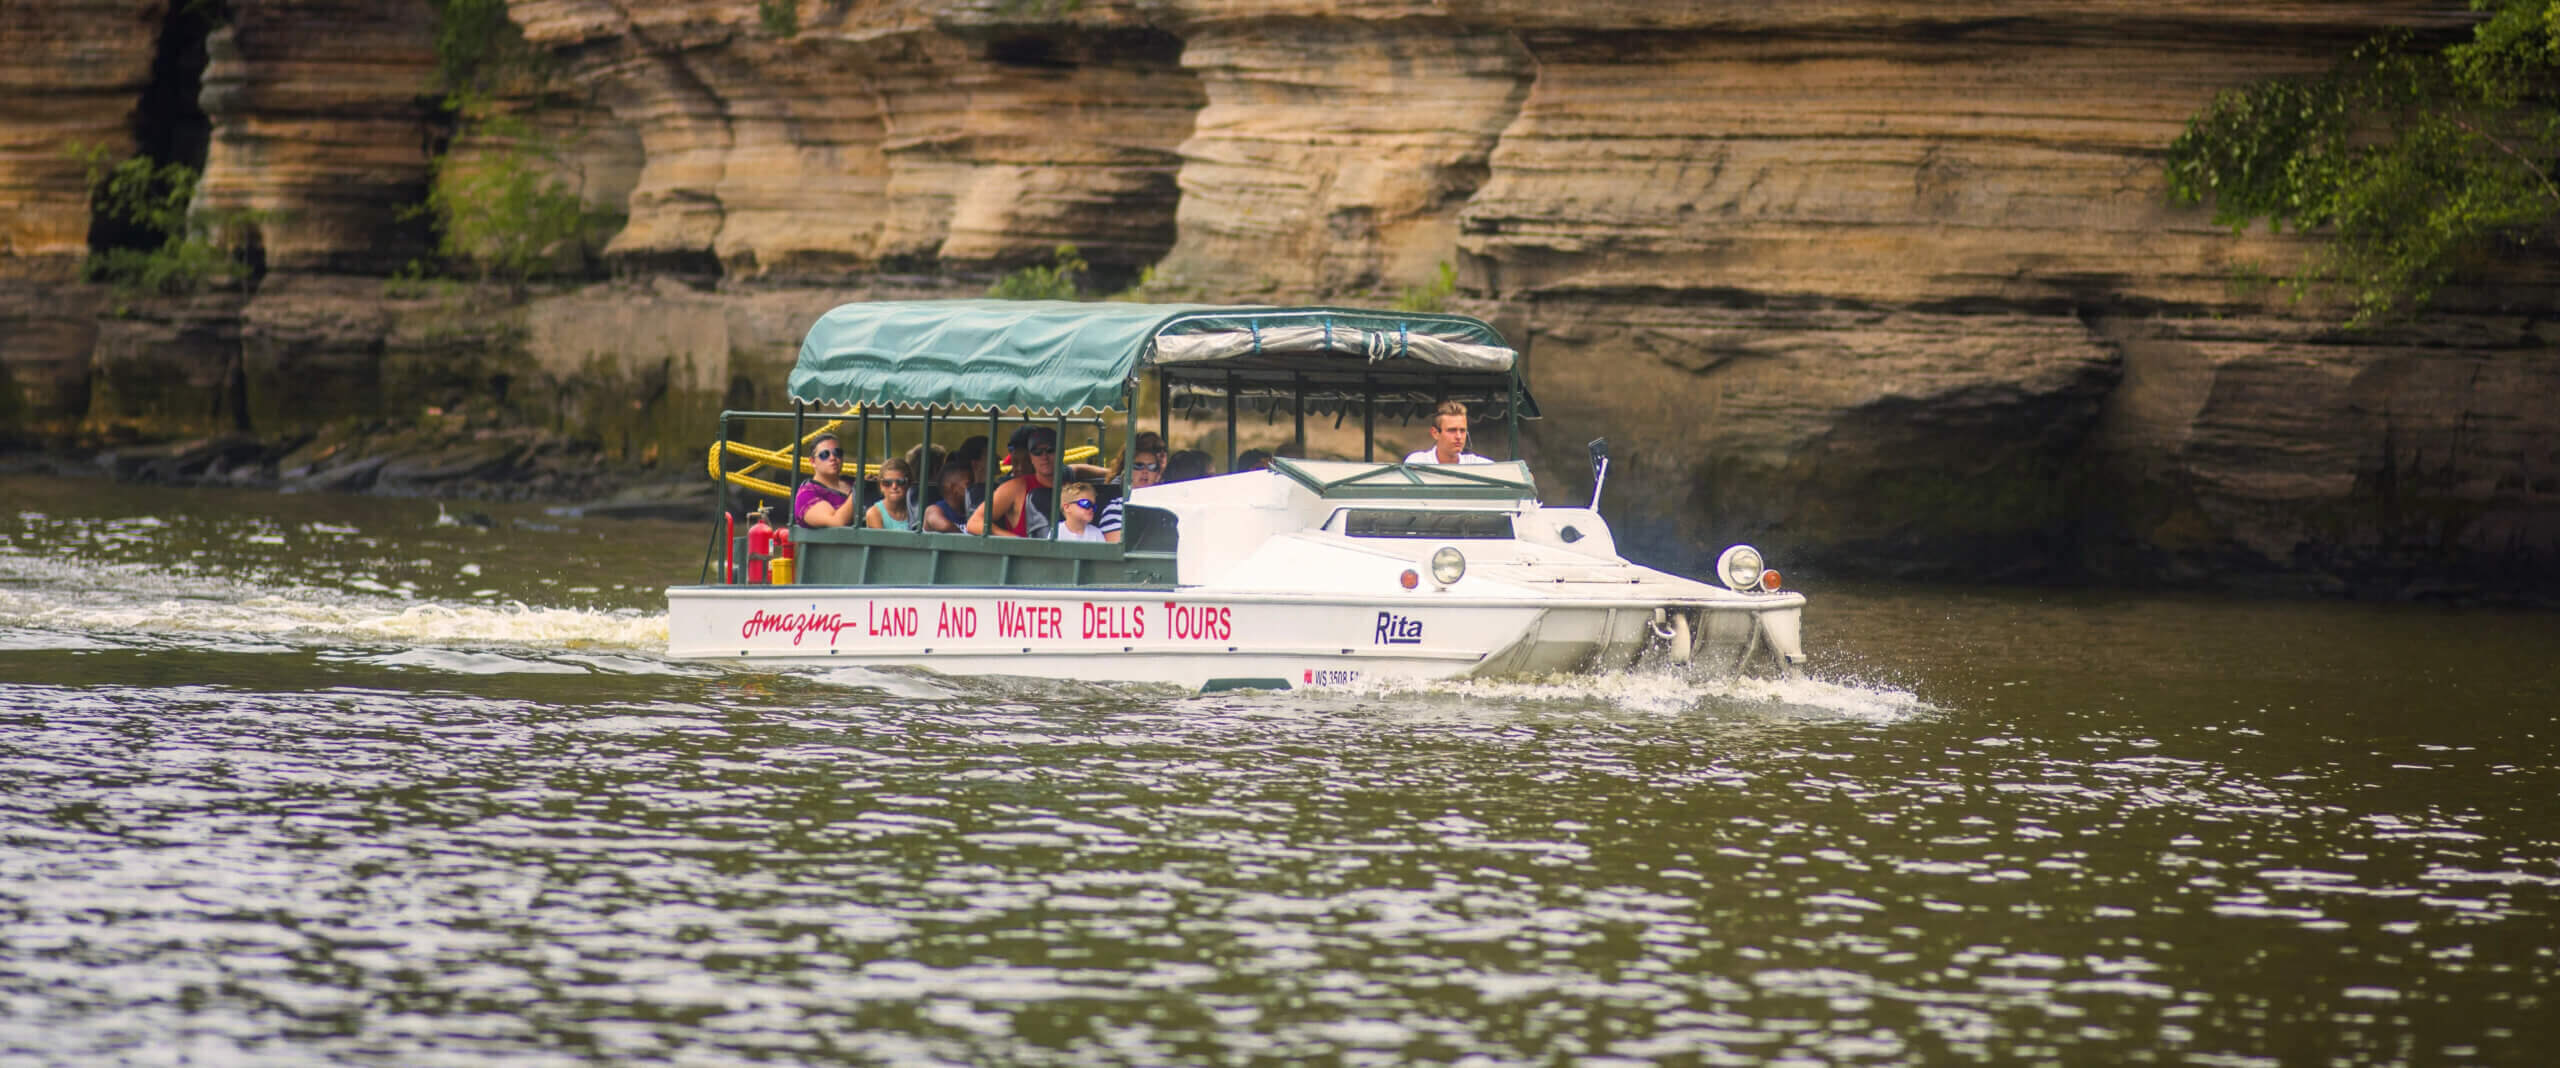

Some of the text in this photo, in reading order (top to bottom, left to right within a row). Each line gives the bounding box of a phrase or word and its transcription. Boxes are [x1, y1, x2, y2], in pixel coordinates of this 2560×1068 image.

[741, 600, 1231, 646] Amazing LAND AND WATER DELLS TOURS
[1374, 611, 1423, 645] Rita
[1315, 670, 1327, 687] WS
